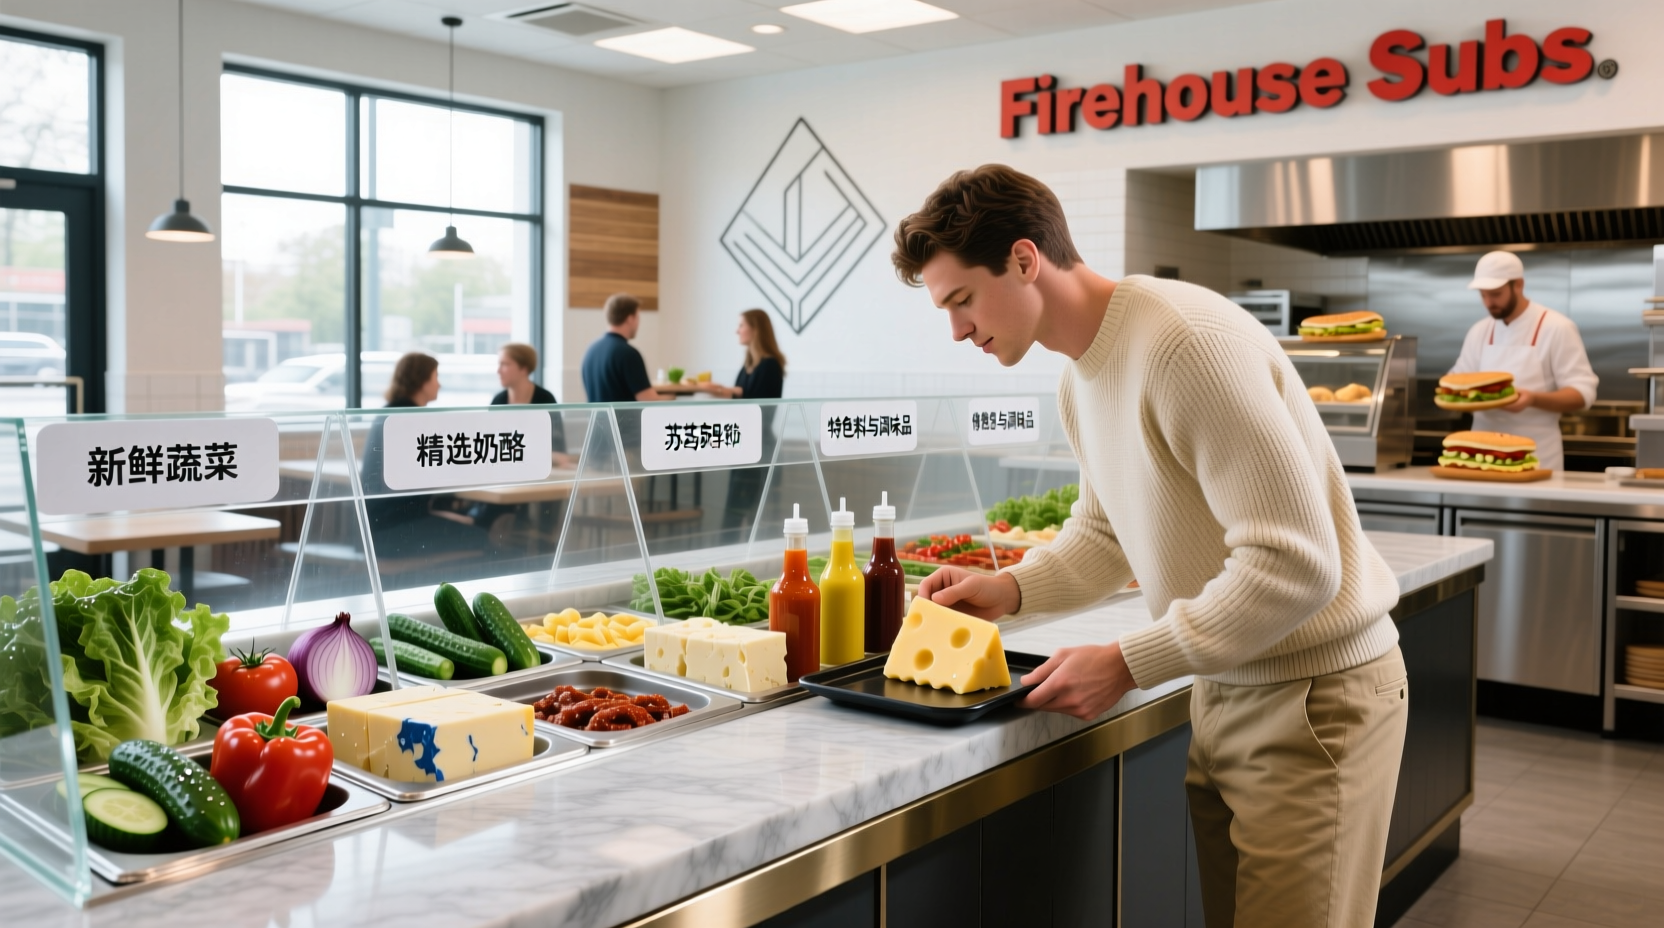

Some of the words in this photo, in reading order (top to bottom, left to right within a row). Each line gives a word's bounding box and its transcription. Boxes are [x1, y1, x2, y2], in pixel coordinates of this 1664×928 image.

[1001, 58, 1350, 138] Firehouse
[87, 442, 238, 487] 新鲜蔬菜
[416, 430, 526, 467] 精选奶酪
